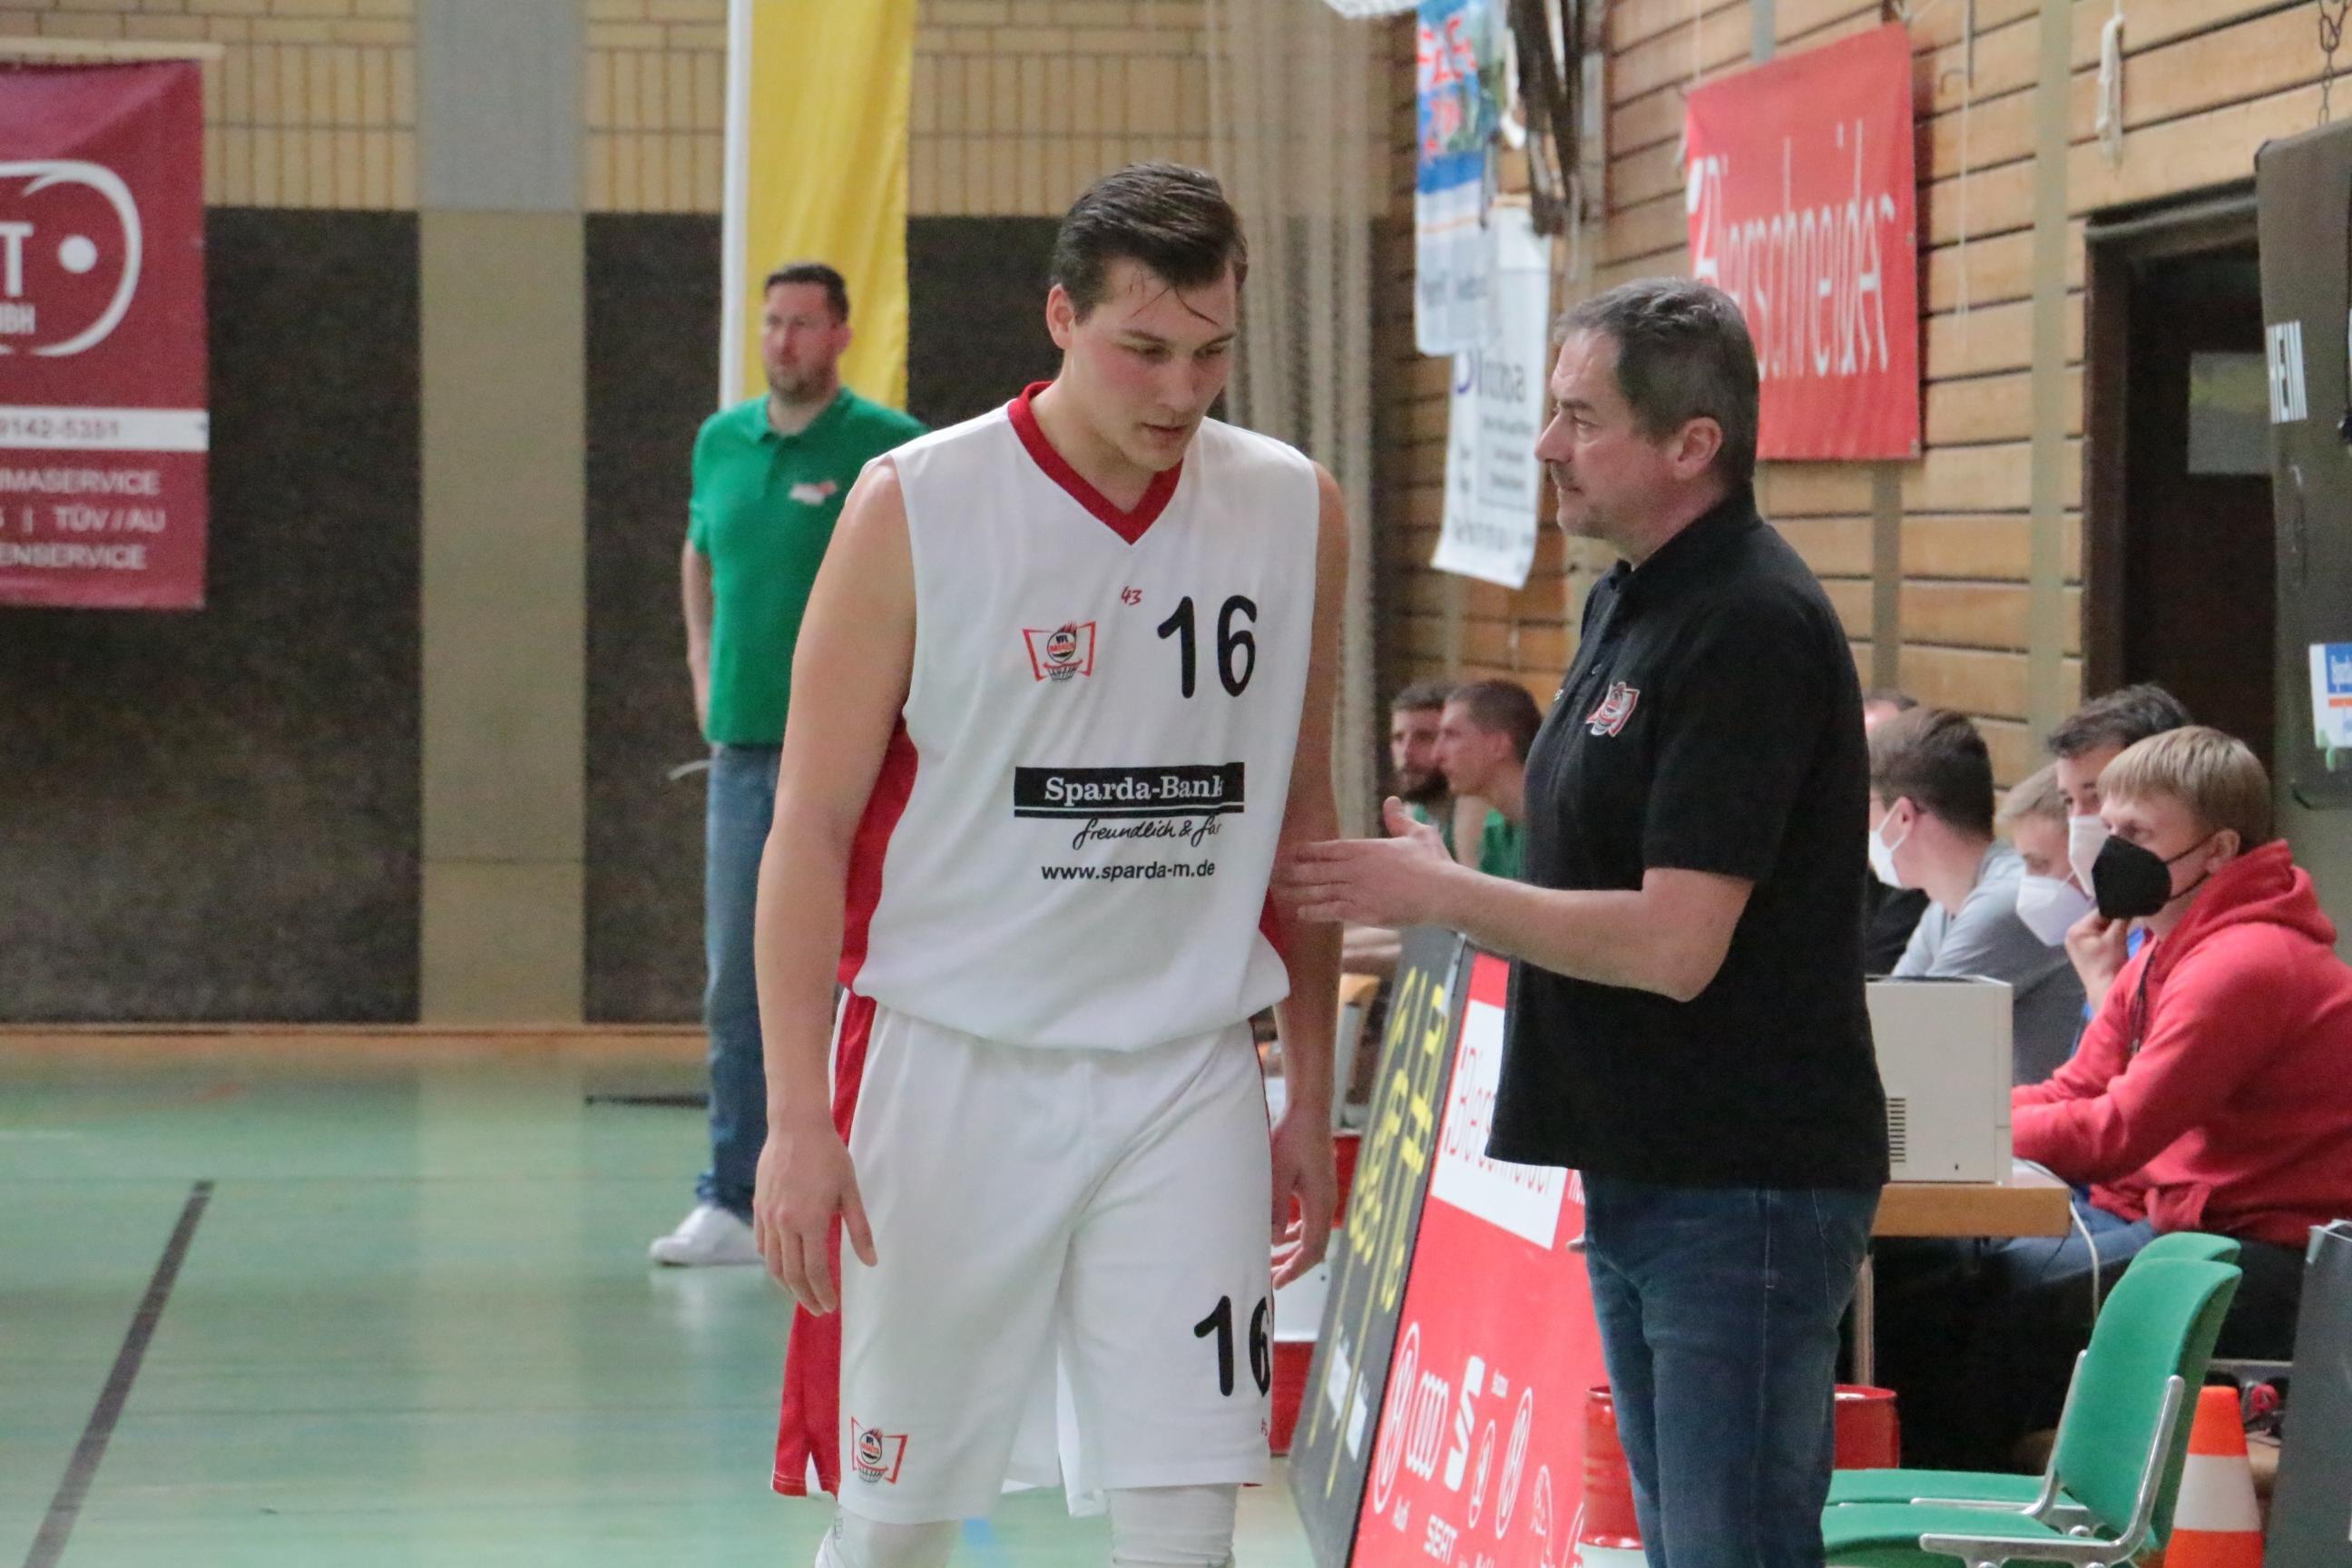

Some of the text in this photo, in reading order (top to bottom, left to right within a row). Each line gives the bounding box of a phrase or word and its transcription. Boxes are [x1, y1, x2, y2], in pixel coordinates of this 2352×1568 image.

[1121, 585, 1142, 606] 43
[1157, 594, 1258, 699] 16
[1072, 817, 1177, 851] freundlich
[1179, 819, 1193, 838] &
[1042, 858, 1216, 883] www.sparda-m.de
[1193, 1295, 1271, 1397] 16
